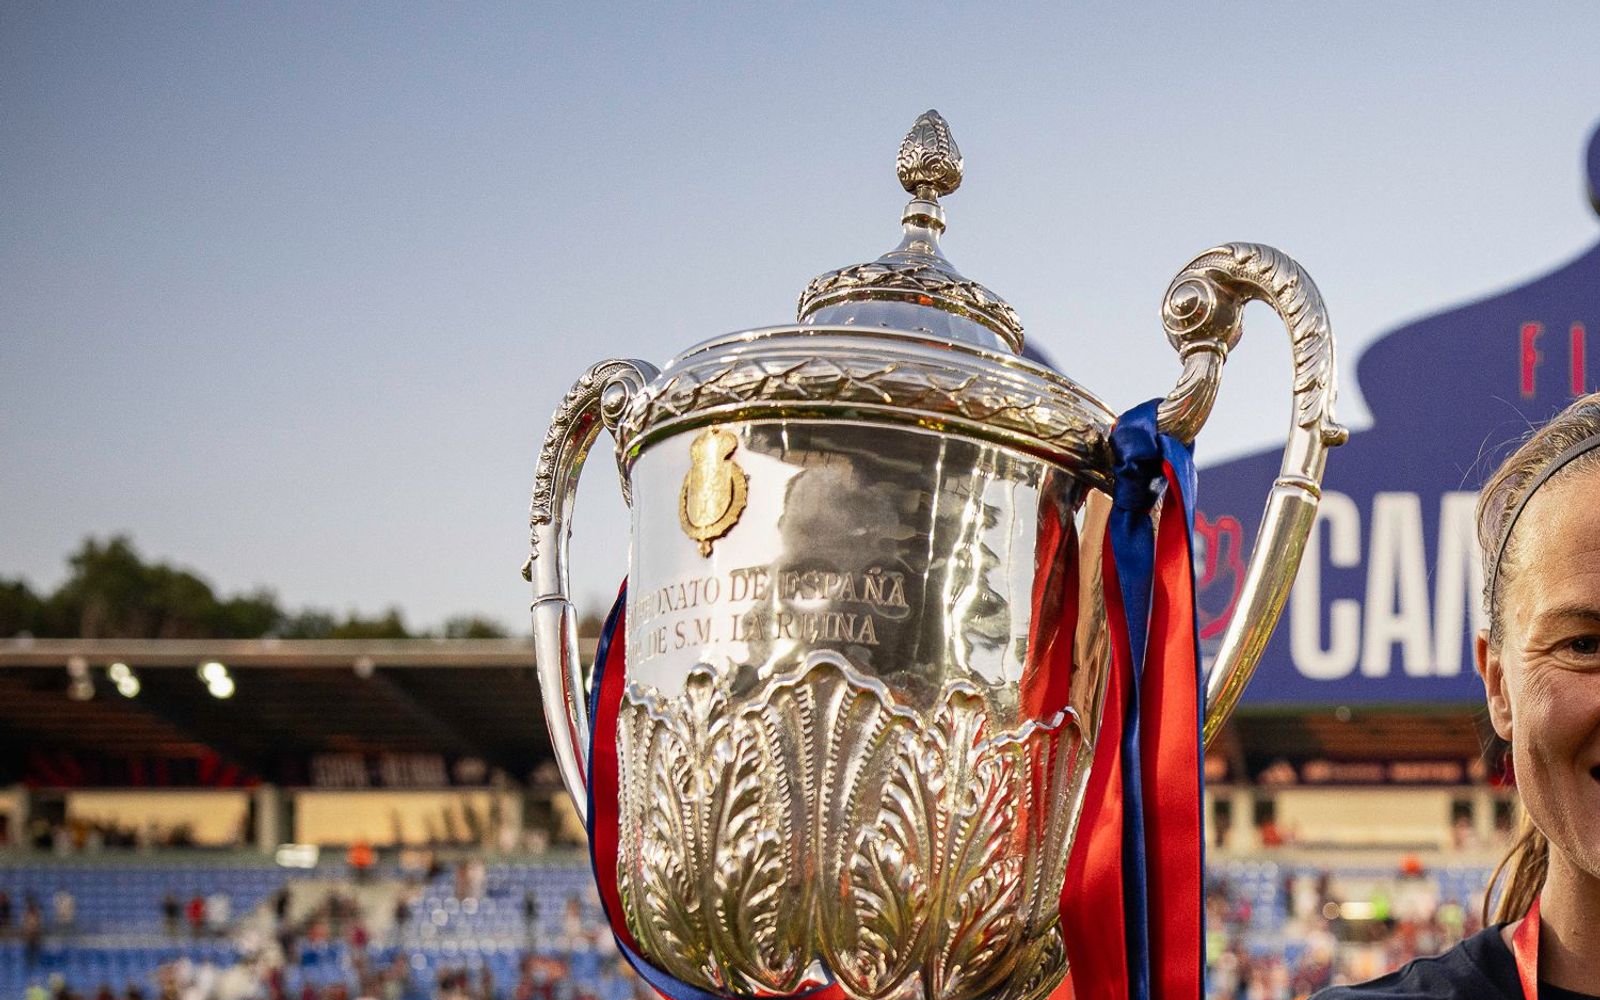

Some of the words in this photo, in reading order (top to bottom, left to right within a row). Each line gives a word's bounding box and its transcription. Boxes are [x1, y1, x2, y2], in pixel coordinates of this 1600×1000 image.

[729, 567, 769, 602] DE
[780, 566, 908, 607] ESPAÑA
[731, 613, 764, 642] LA
[777, 612, 880, 645] REINA
